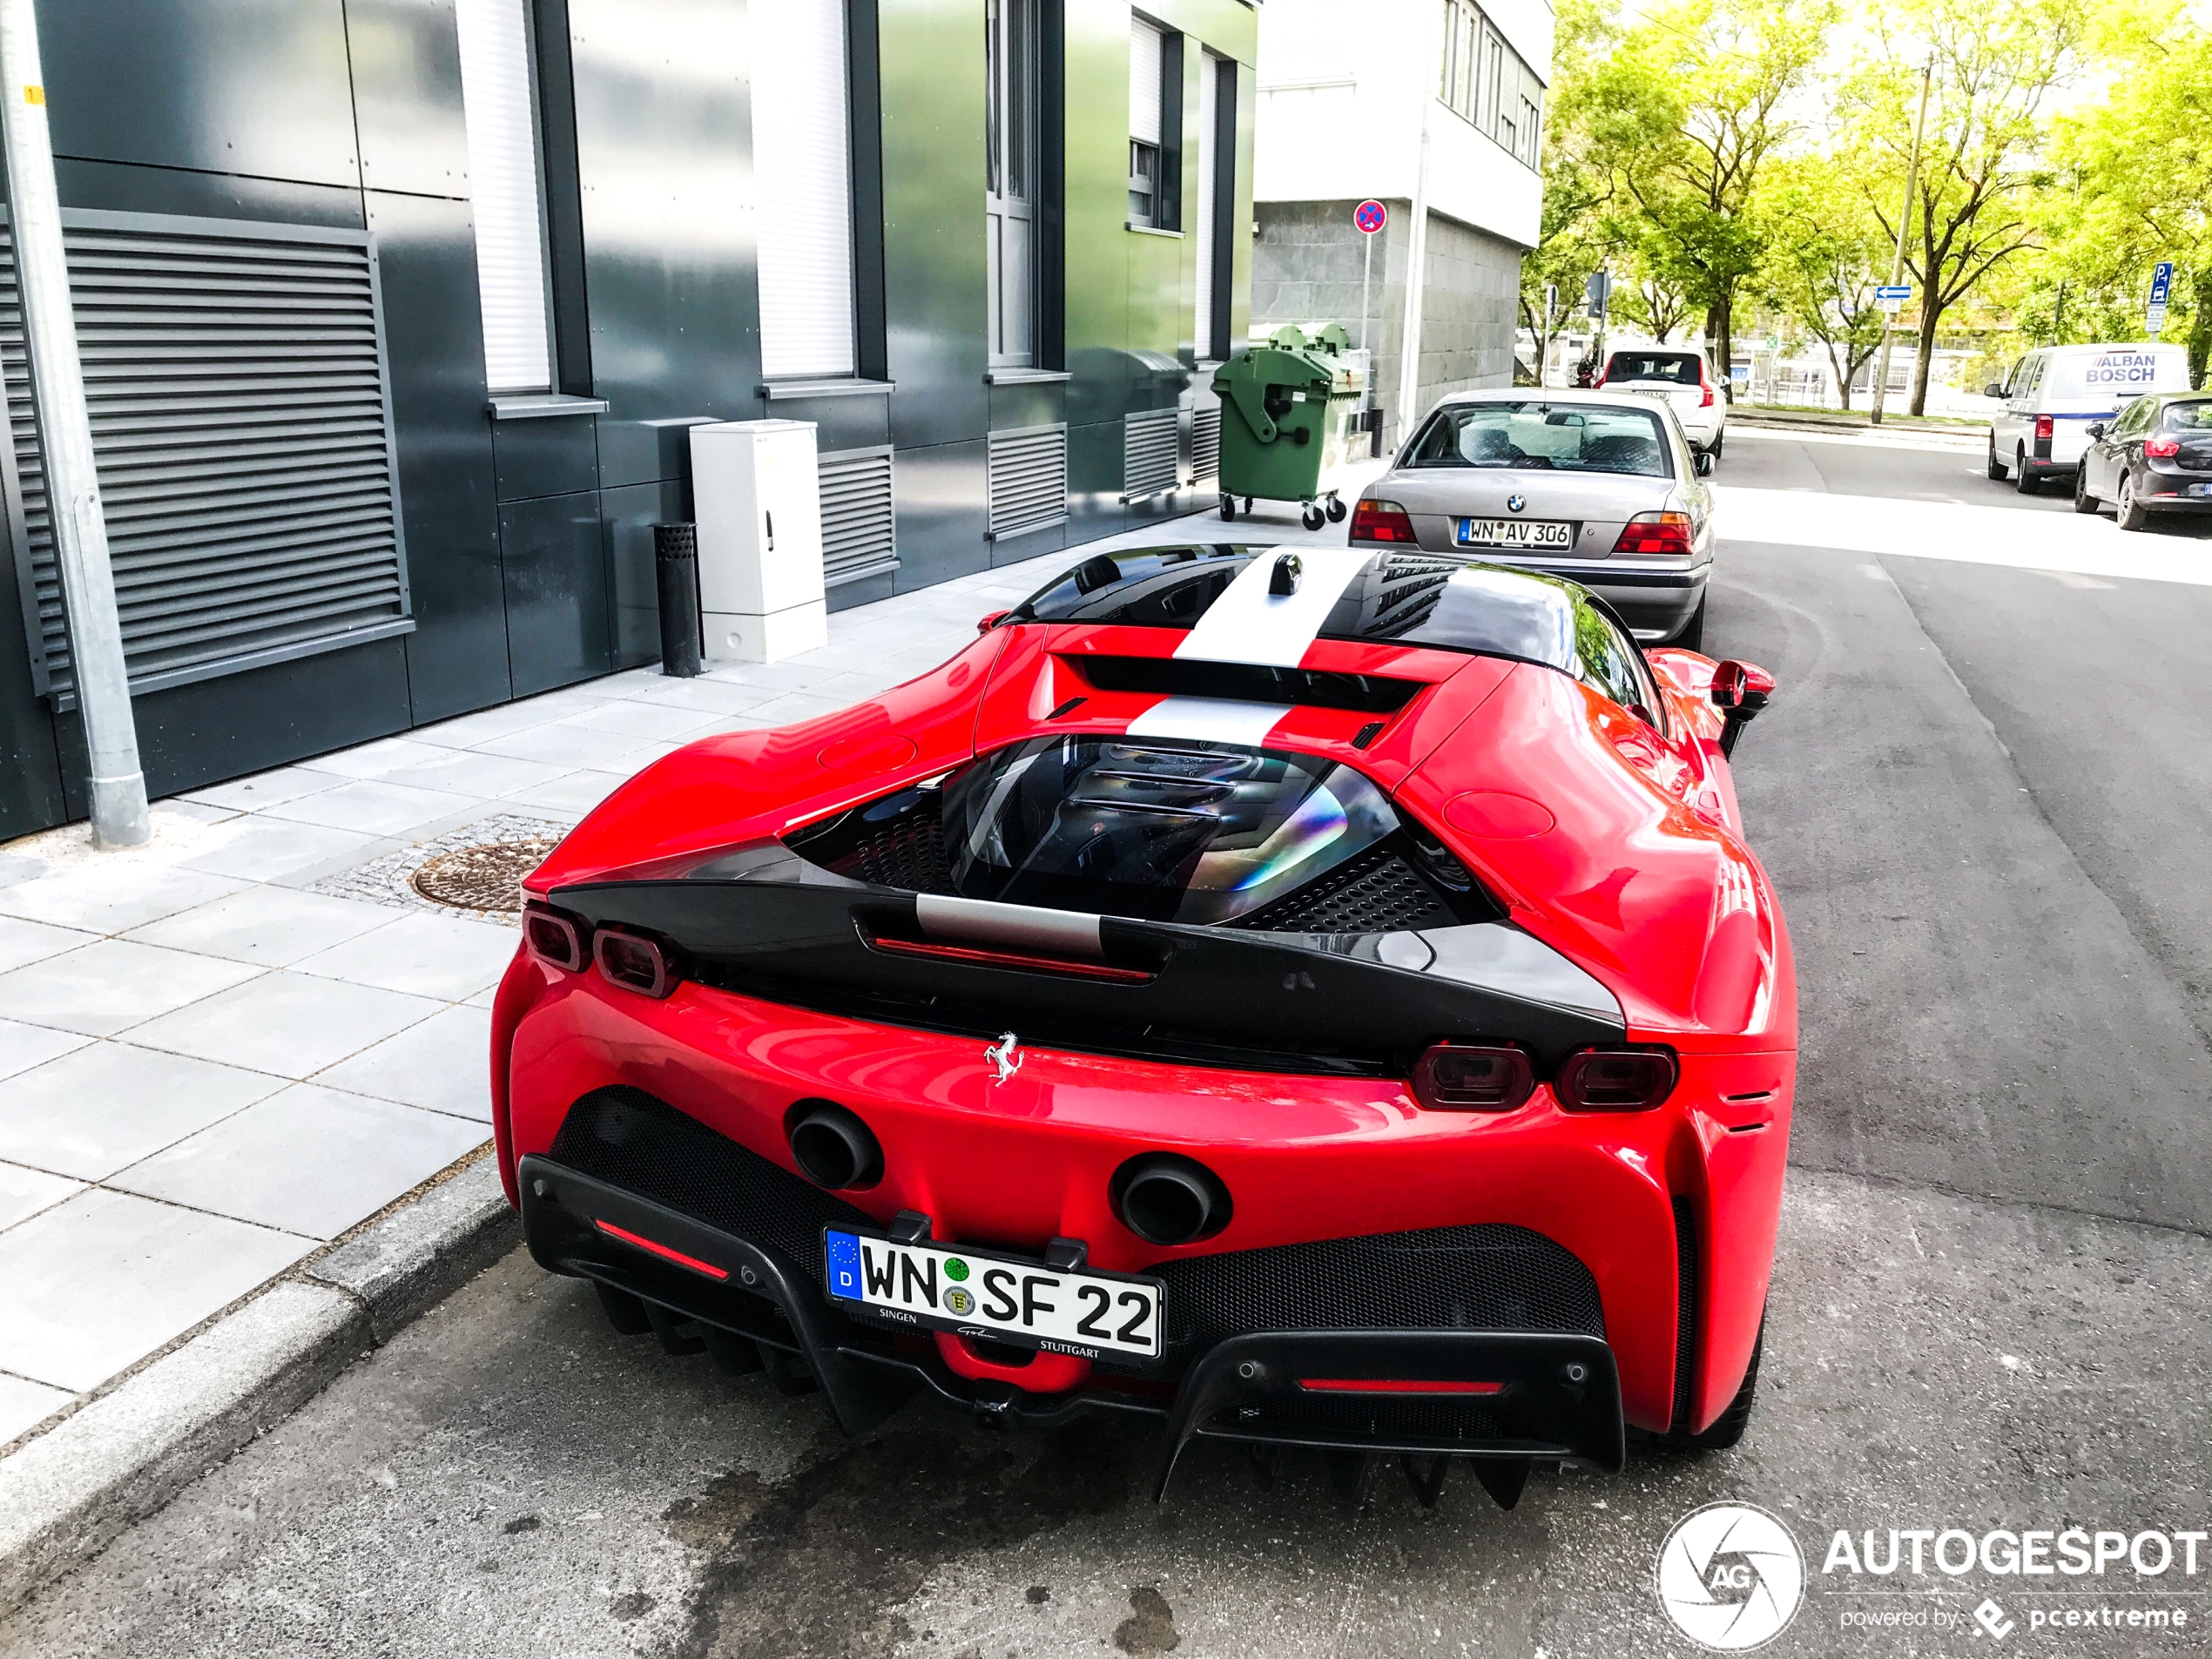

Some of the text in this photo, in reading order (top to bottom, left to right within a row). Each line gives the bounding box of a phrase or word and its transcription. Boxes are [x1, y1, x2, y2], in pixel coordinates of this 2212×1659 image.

[2155, 265, 2166, 282] P
[2101, 355, 2155, 367] ALBAN
[2086, 368, 2155, 382] BOSCH
[1471, 522, 1568, 543] WN AV 306
[840, 1271, 853, 1286] D
[862, 1244, 938, 1308] WN
[982, 1268, 1061, 1326] SF
[1077, 1285, 1151, 1346] 22
[879, 1308, 917, 1324] SINGEN
[1040, 1340, 1099, 1359] STUTTGART
